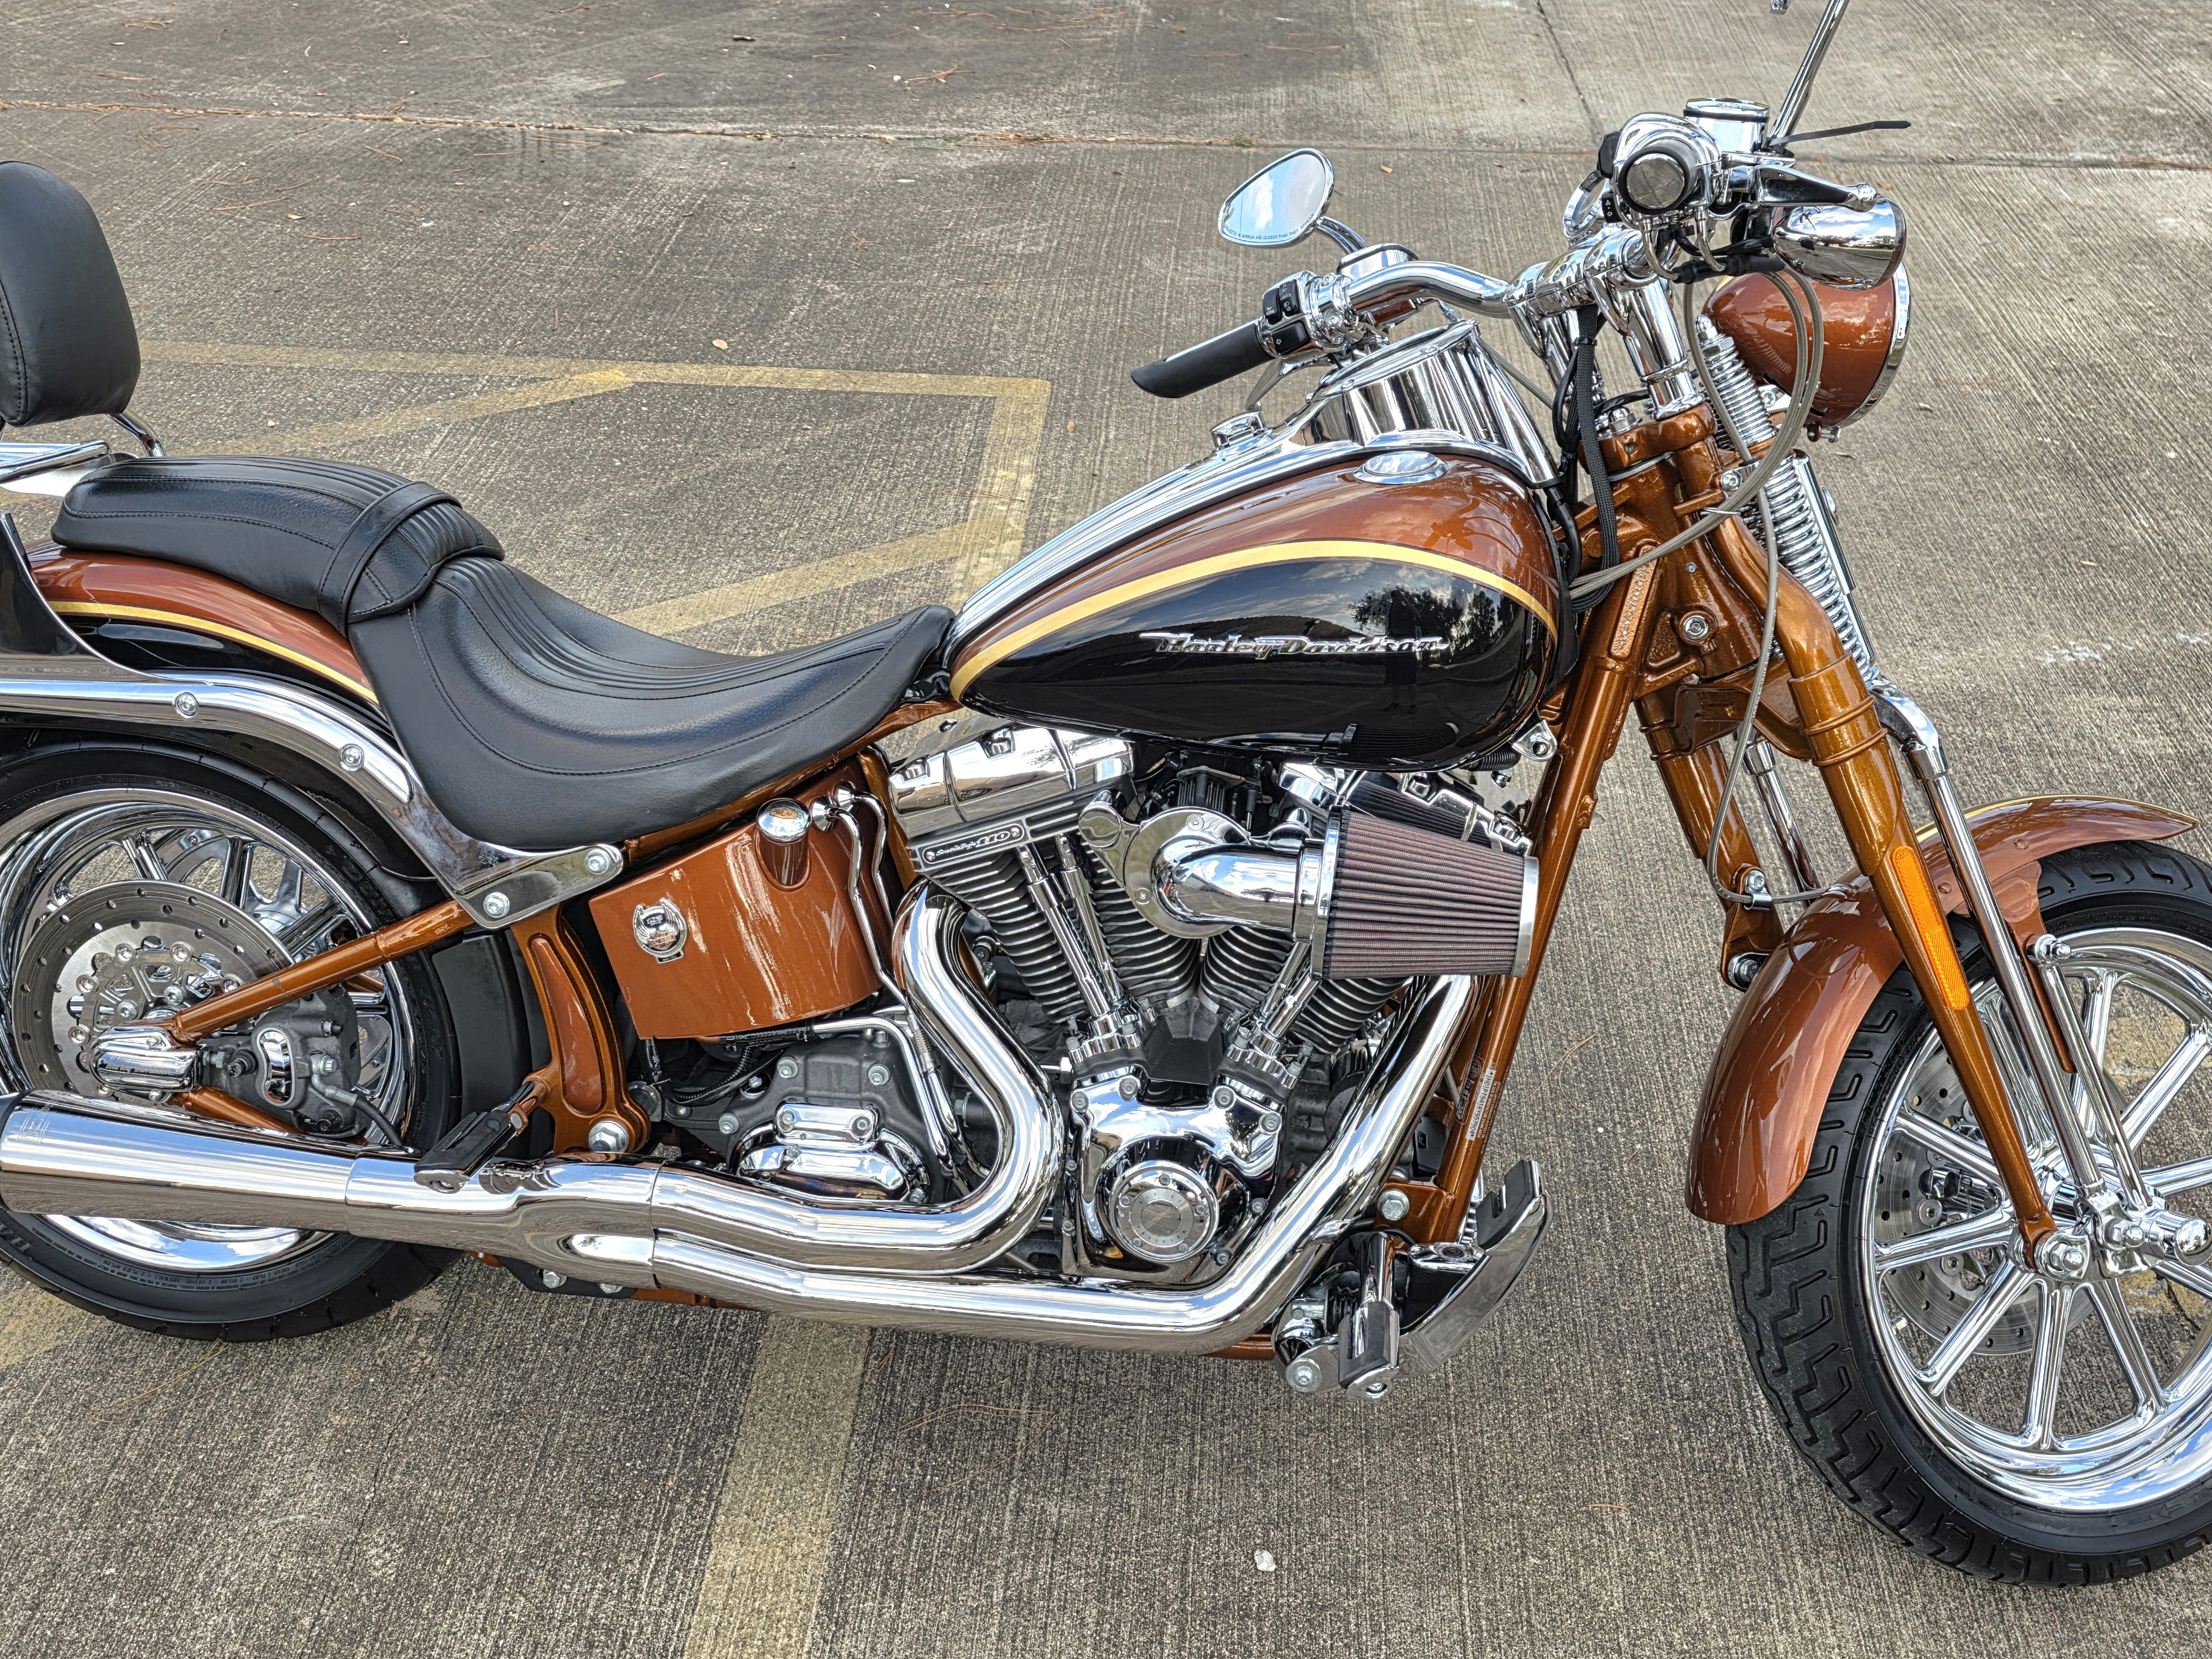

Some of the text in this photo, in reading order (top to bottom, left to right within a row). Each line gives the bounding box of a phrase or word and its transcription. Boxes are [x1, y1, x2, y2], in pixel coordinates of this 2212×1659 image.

[1225, 225, 1237, 236] OBJECTS
[1300, 213, 1314, 230] APPEAR
[975, 831, 1010, 847] 110
